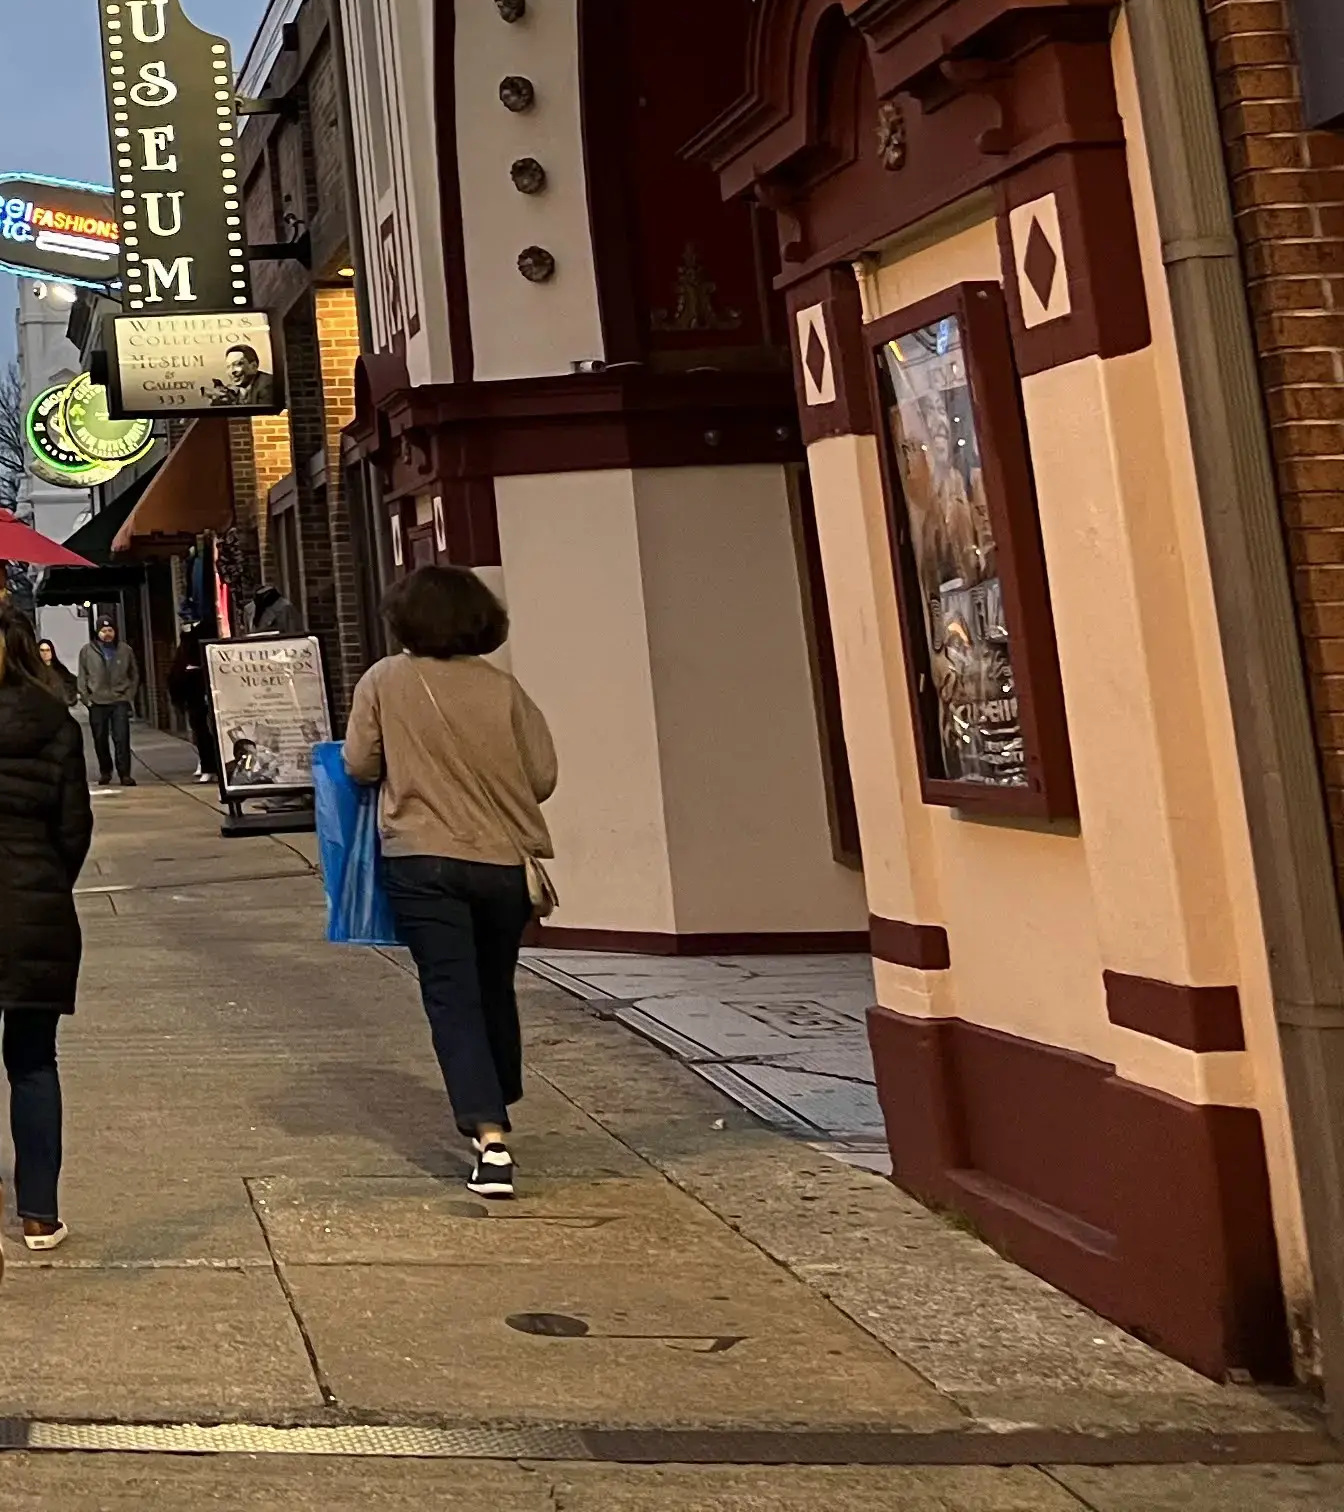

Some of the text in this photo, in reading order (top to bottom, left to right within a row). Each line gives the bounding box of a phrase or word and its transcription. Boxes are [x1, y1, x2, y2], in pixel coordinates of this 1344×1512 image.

[128, 317, 253, 334] WITHERS
[128, 332, 253, 347] COLLECTION
[142, 379, 196, 392] GALLERY
[240, 675, 292, 687] MUSEU
